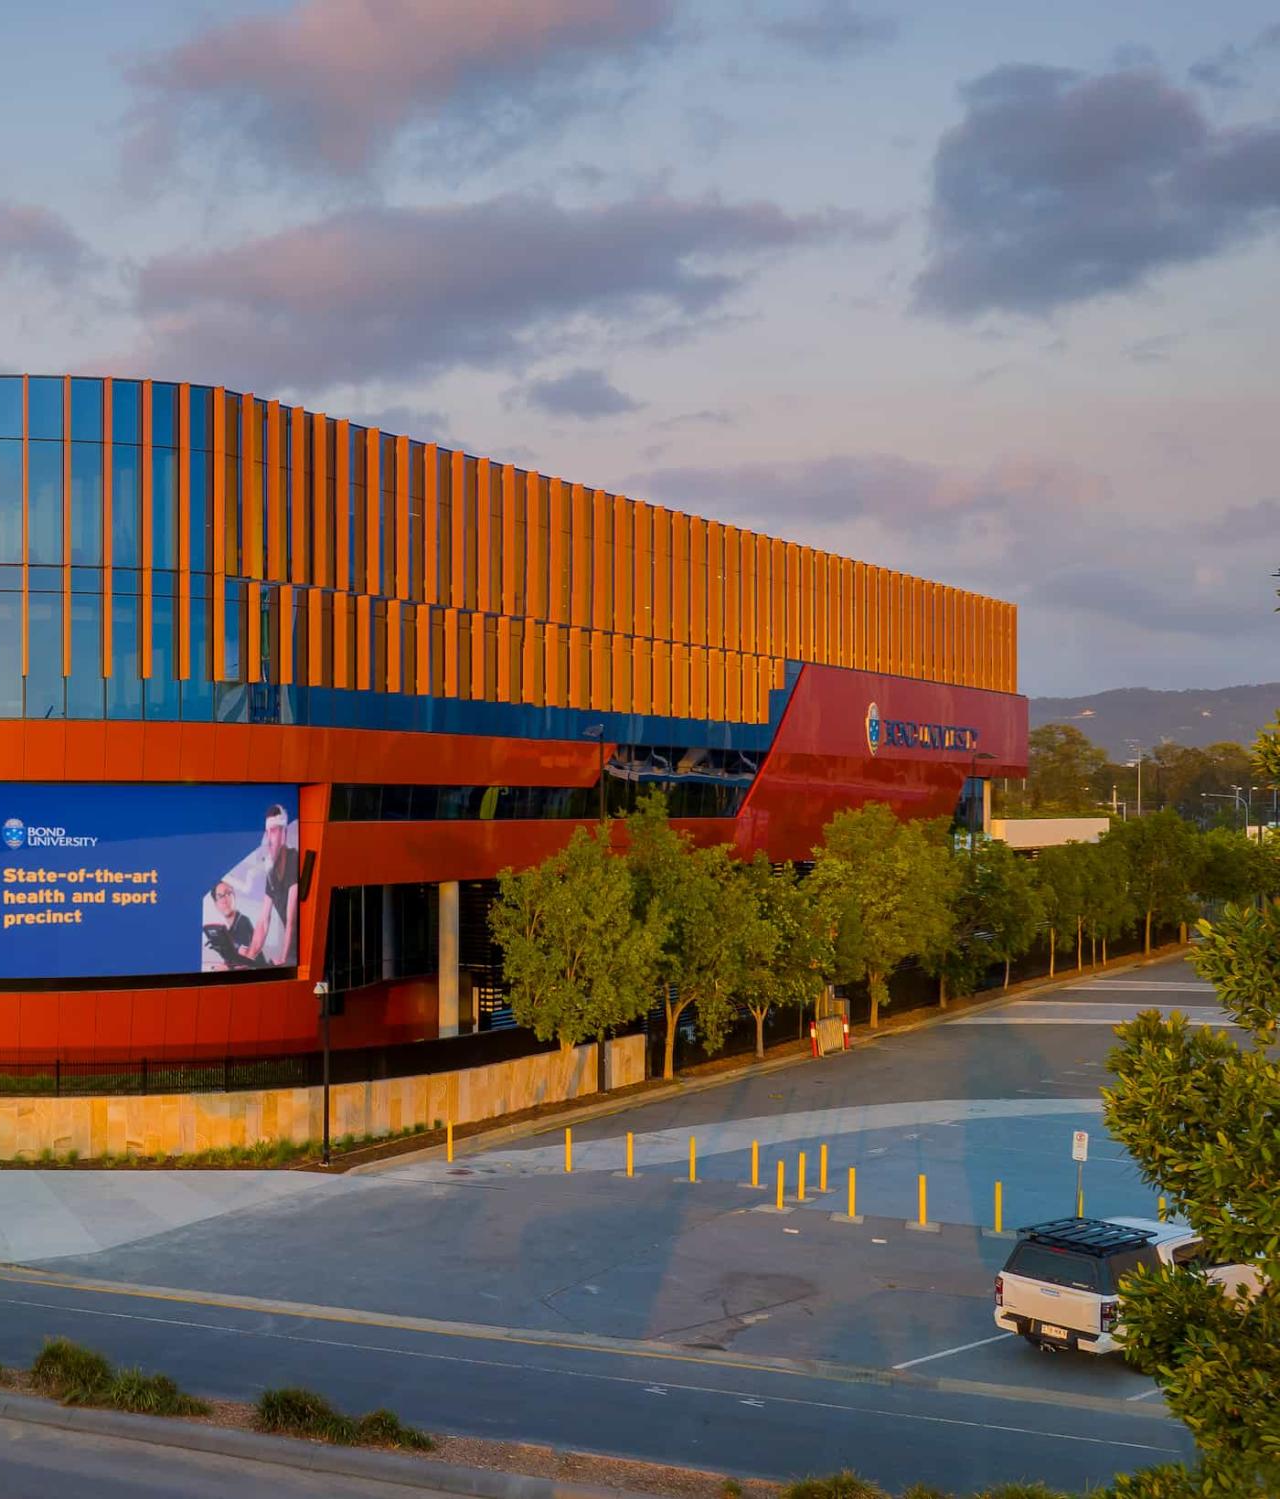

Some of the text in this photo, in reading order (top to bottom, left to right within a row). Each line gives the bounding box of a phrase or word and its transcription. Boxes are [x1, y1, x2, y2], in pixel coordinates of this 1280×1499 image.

[27, 826, 66, 837] BOND
[27, 836, 98, 847] UNIVERSITY
[3, 867, 158, 883] State-of-the-art
[3, 889, 157, 906] health and sport
[3, 908, 82, 929] precinct
